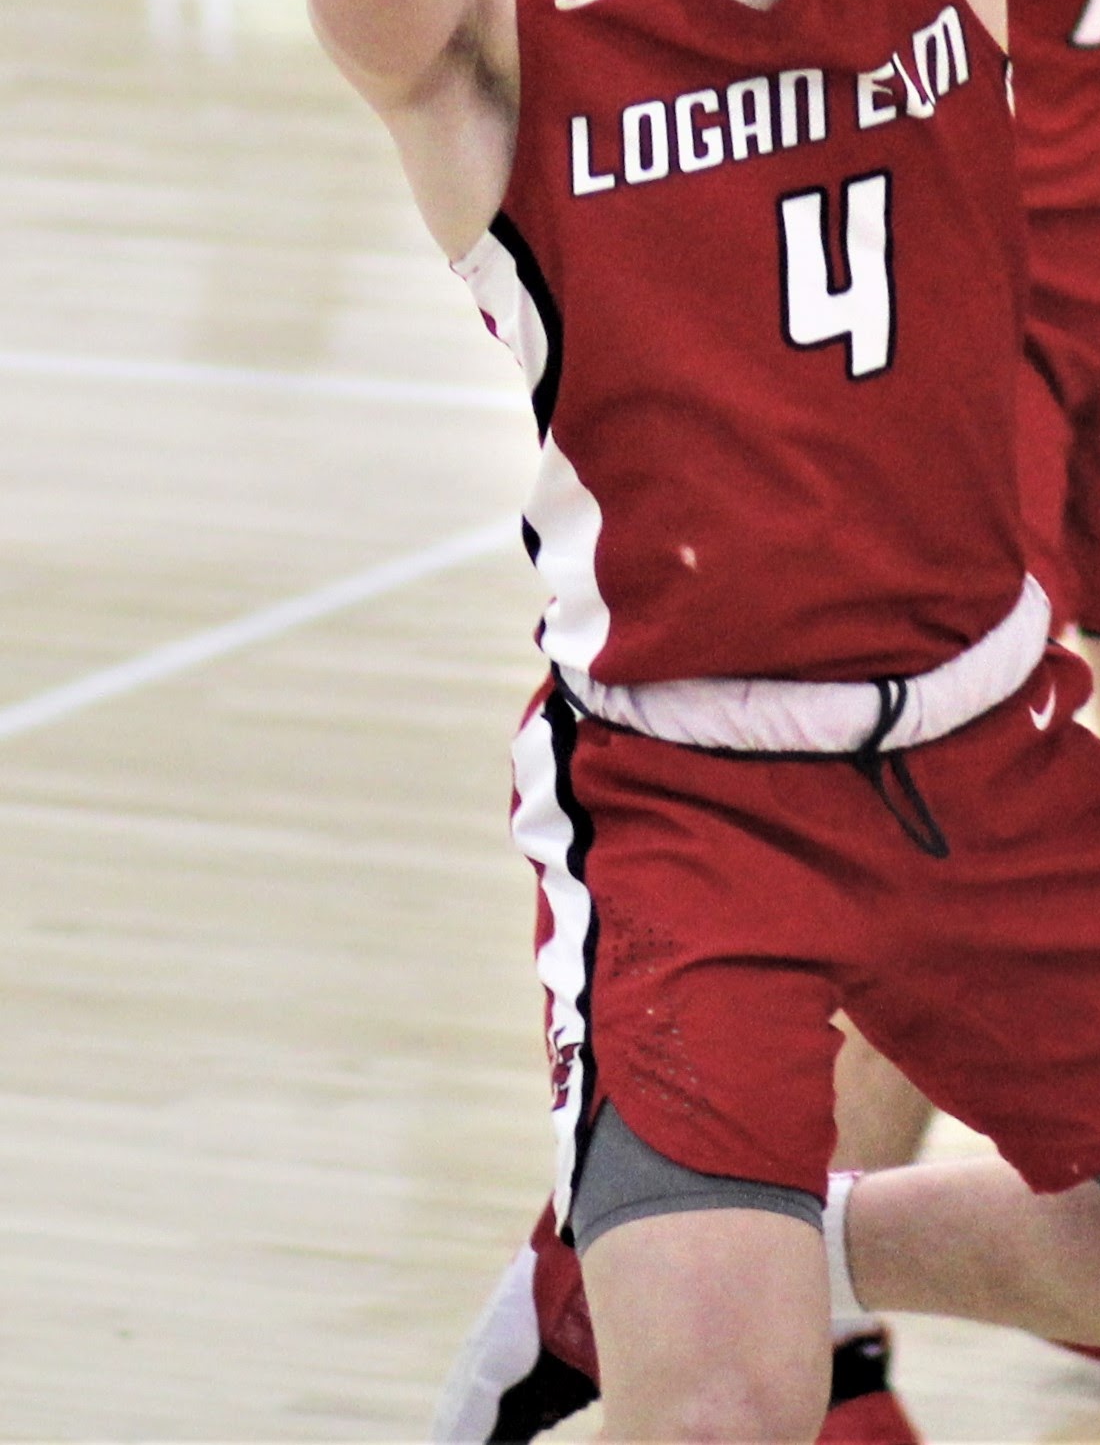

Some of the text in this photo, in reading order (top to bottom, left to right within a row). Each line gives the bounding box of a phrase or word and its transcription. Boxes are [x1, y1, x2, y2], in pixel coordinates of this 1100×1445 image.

[570, 4, 970, 197] LOGAN ELM
[778, 169, 893, 380] 4
